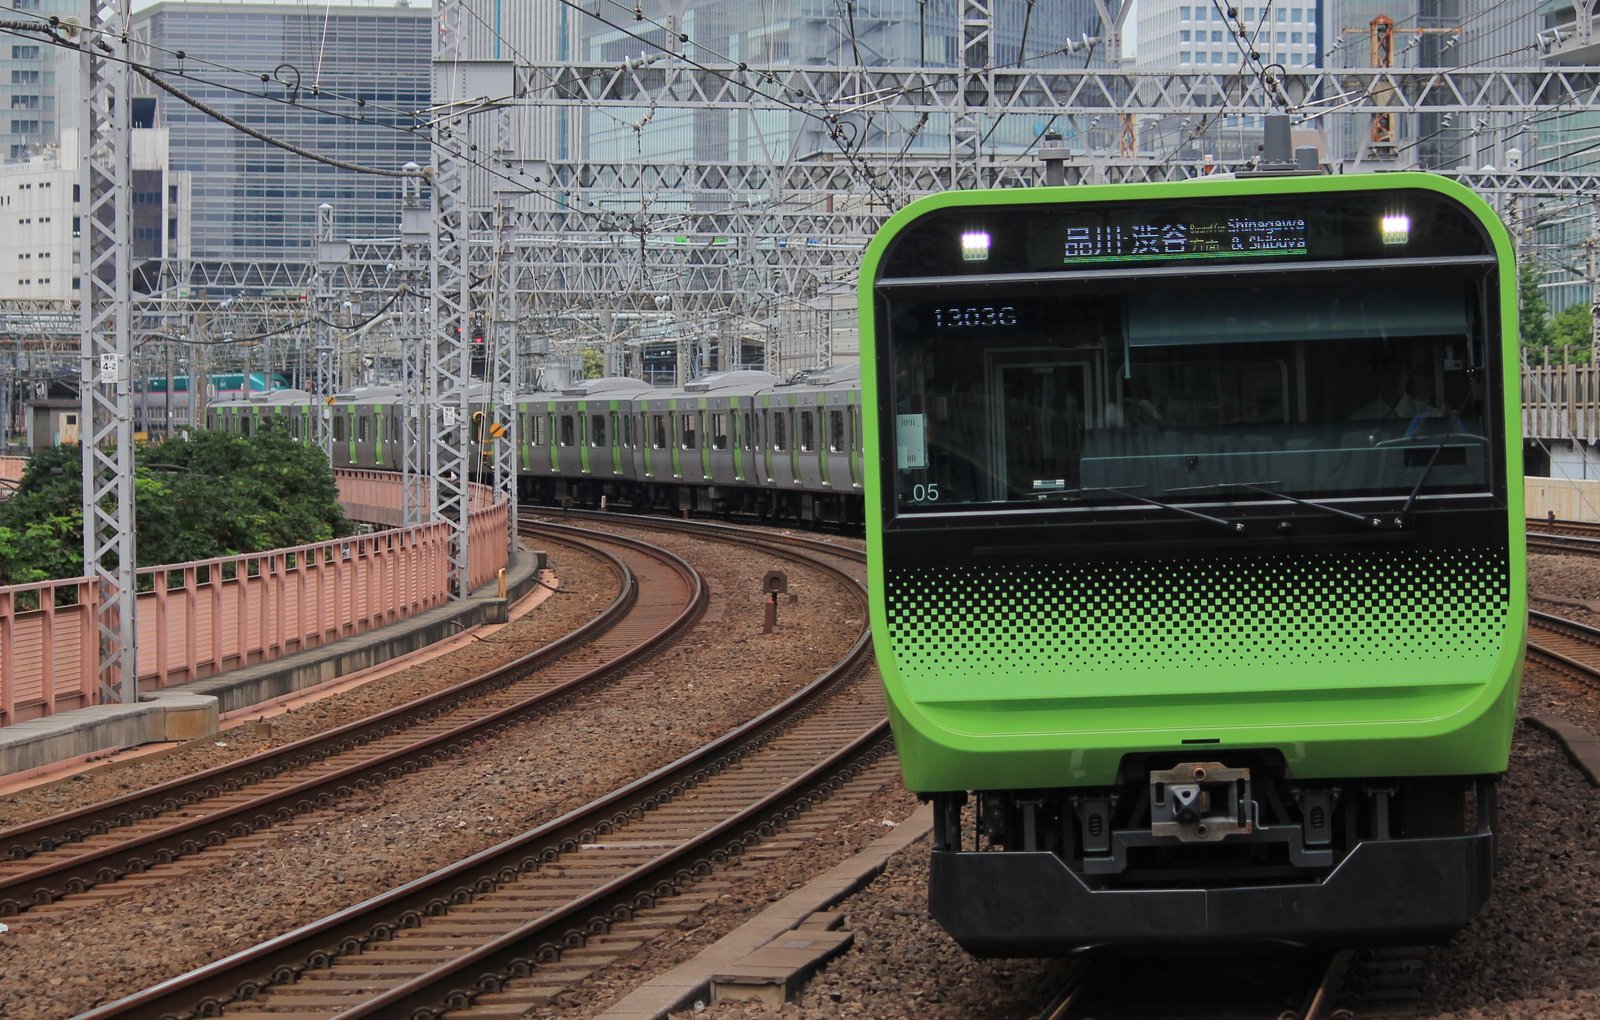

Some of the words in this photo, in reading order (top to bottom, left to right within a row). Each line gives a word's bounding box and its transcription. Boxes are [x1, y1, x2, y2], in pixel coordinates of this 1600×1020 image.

[1228, 218, 1305, 234] Shinagawa
[1231, 236, 1244, 250] &
[1248, 235, 1306, 252] Shibuya
[934, 307, 1016, 326] 1303G
[103, 362, 117, 371] 4-2
[913, 483, 939, 501] 05
